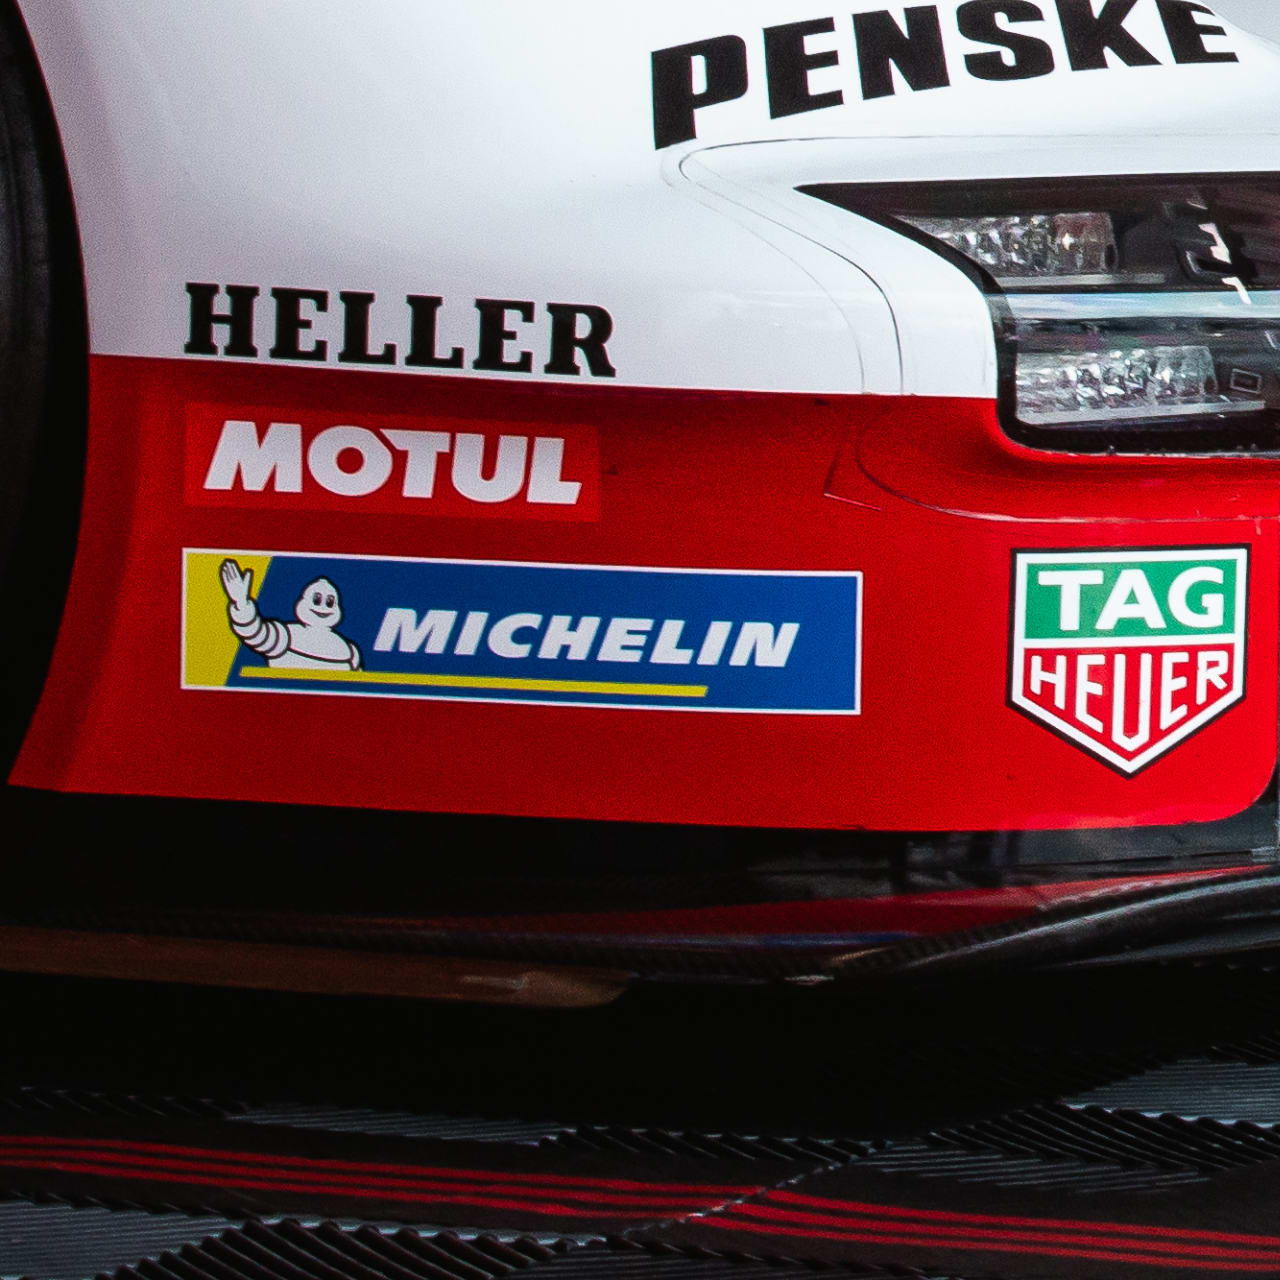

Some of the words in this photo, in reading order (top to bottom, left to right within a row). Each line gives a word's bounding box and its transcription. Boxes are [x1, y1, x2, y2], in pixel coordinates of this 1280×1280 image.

[184, 281, 617, 378] HELLER
[203, 419, 583, 505] MOTUL
[373, 606, 800, 668] MICHELIN
[1038, 566, 1226, 631] TAG
[1029, 650, 1230, 752] HEUER
